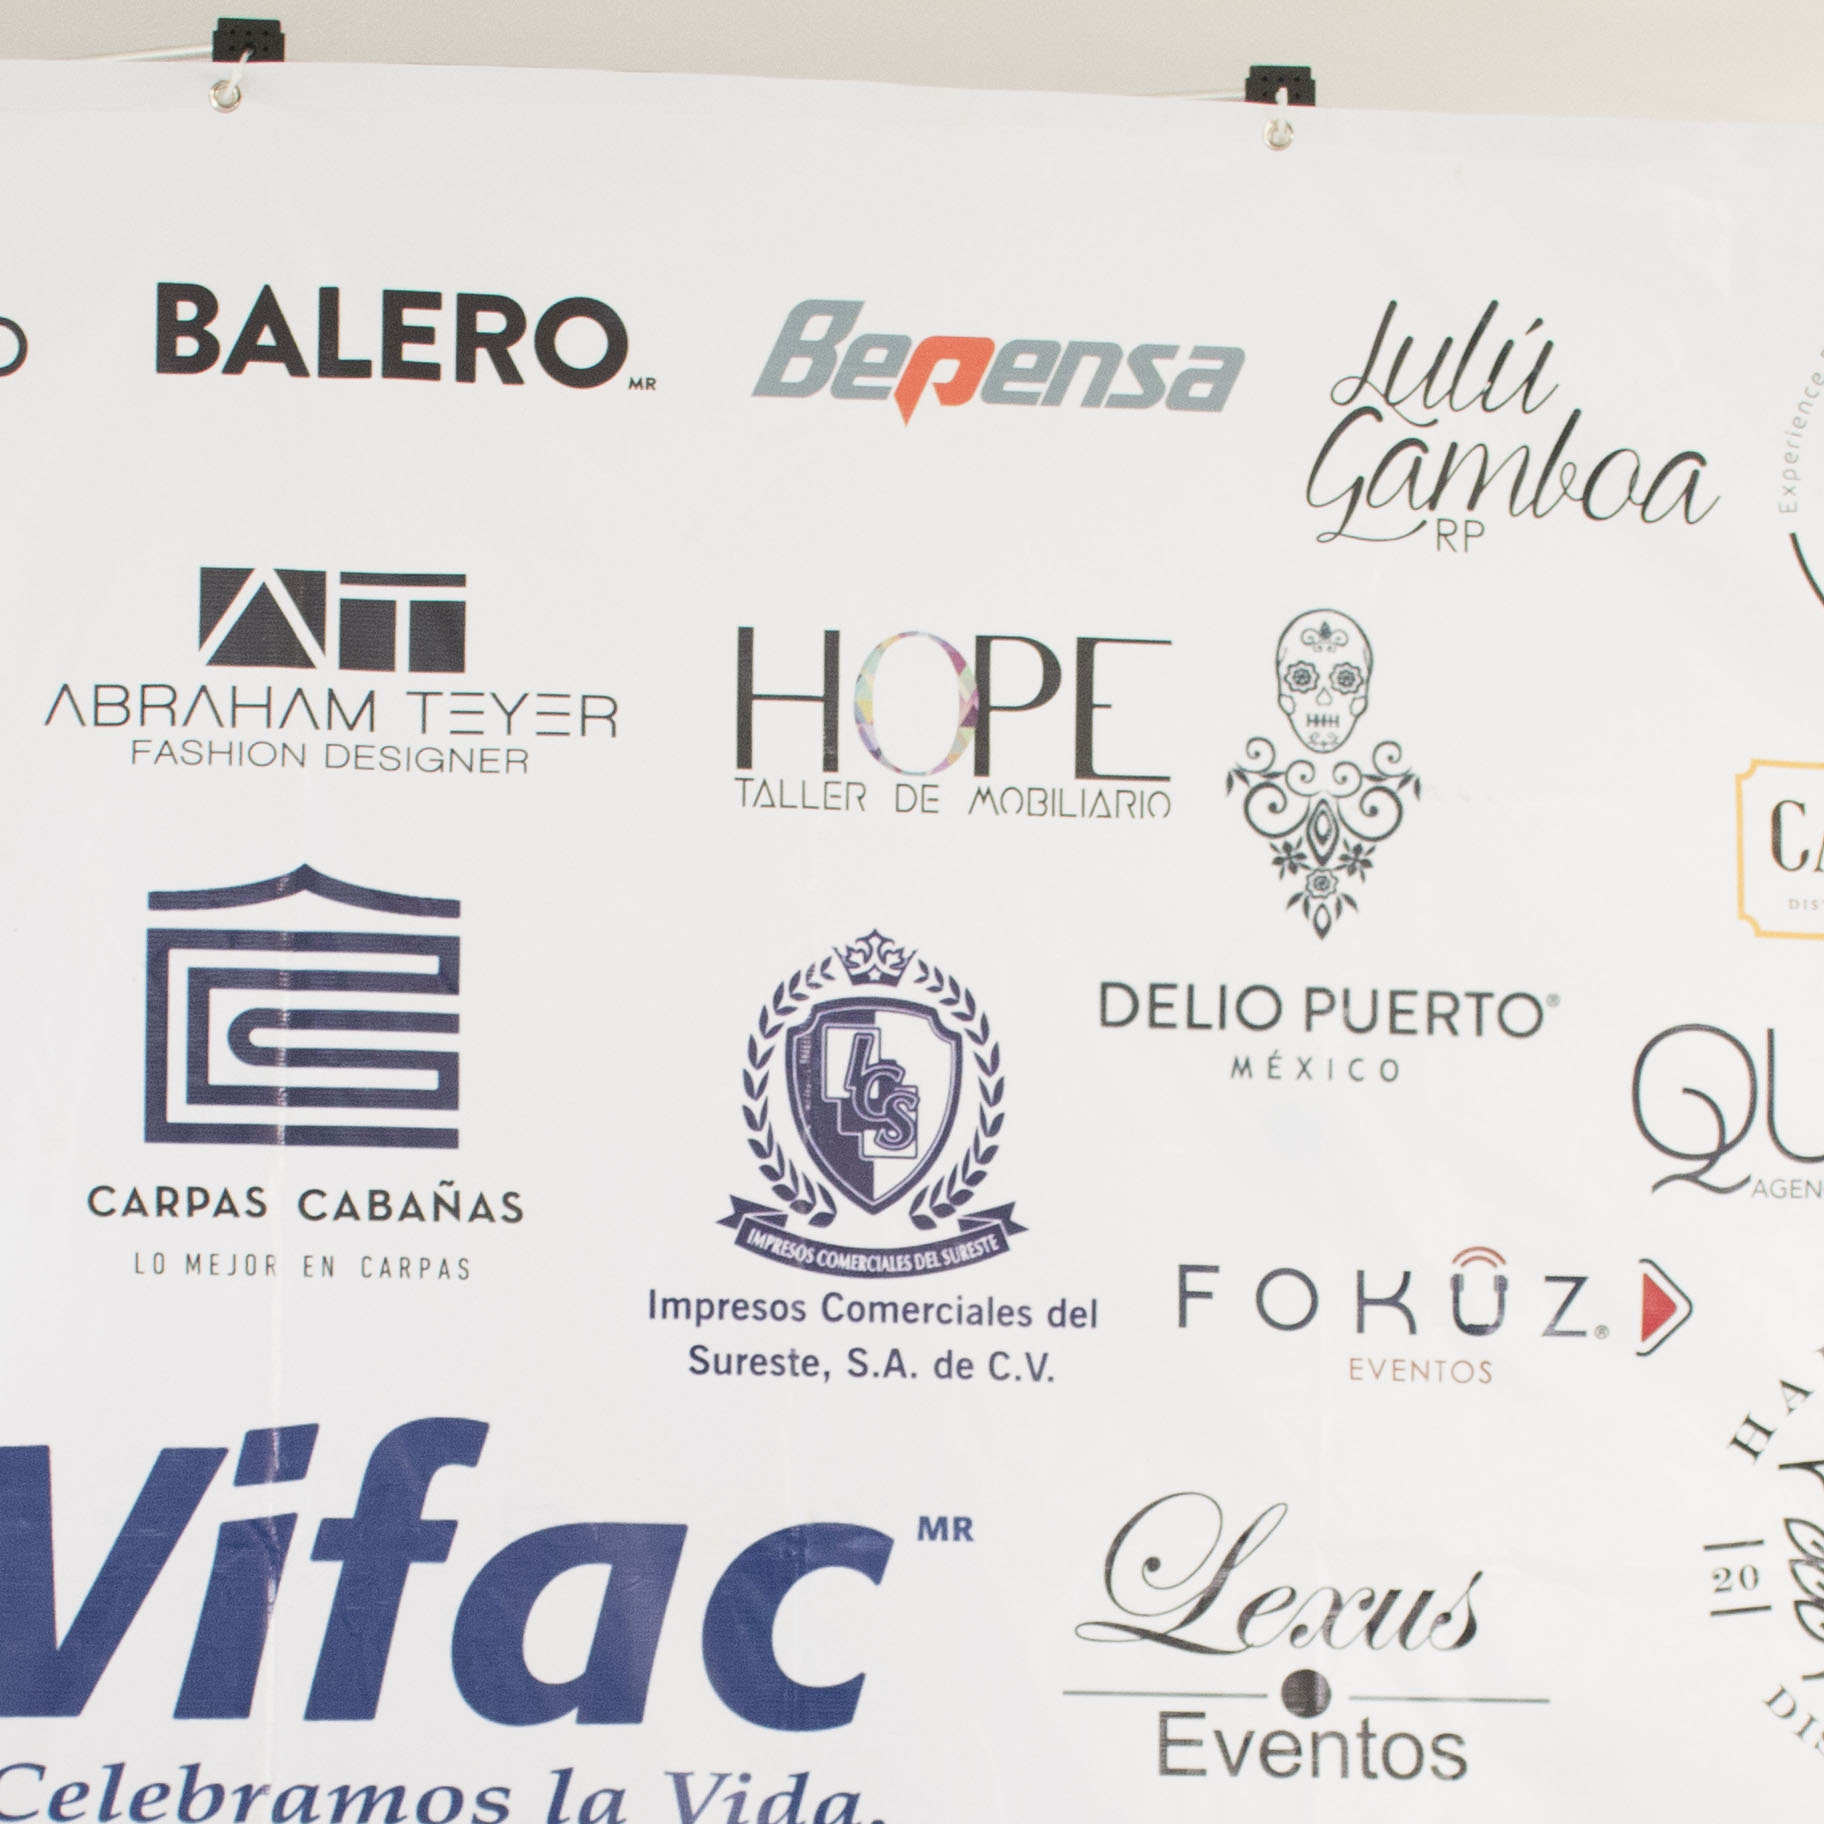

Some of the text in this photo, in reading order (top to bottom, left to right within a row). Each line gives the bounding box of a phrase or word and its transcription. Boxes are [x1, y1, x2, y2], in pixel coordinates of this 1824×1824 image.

[156, 282, 628, 389] BALERO
[753, 299, 1244, 425] Bepensa
[1330, 299, 1558, 428] Lulú
[1306, 406, 1719, 542] Gamboa
[1437, 517, 1485, 552] RP
[45, 683, 618, 738] ABRAHAM TEYER
[735, 626, 1172, 780] HOPE
[131, 739, 528, 774] FASHION DESIGNER
[734, 777, 1171, 819] TALLER DE MOBILIARIO
[1100, 981, 1282, 1032] DELIO
[1230, 1049, 1399, 1083] MÉXICO
[87, 1180, 523, 1223] CARPAS CABAÑAS
[135, 1251, 472, 1282] LO MEJOR EN CARPAS
[747, 1227, 1000, 1273] IMPRESOS COMERCIALES DEL SURESTE
[649, 1289, 1097, 1333] Impresos Comerciales del
[689, 1344, 1054, 1382] Sureste, S.A. de C.V.
[1349, 1358, 1492, 1384] EVENTOS
[917, 1516, 974, 1544] MR
[1075, 1492, 1483, 1655] Lexus
[1711, 1564, 1759, 1593] 20
[1159, 1710, 1467, 1781] Eventos
